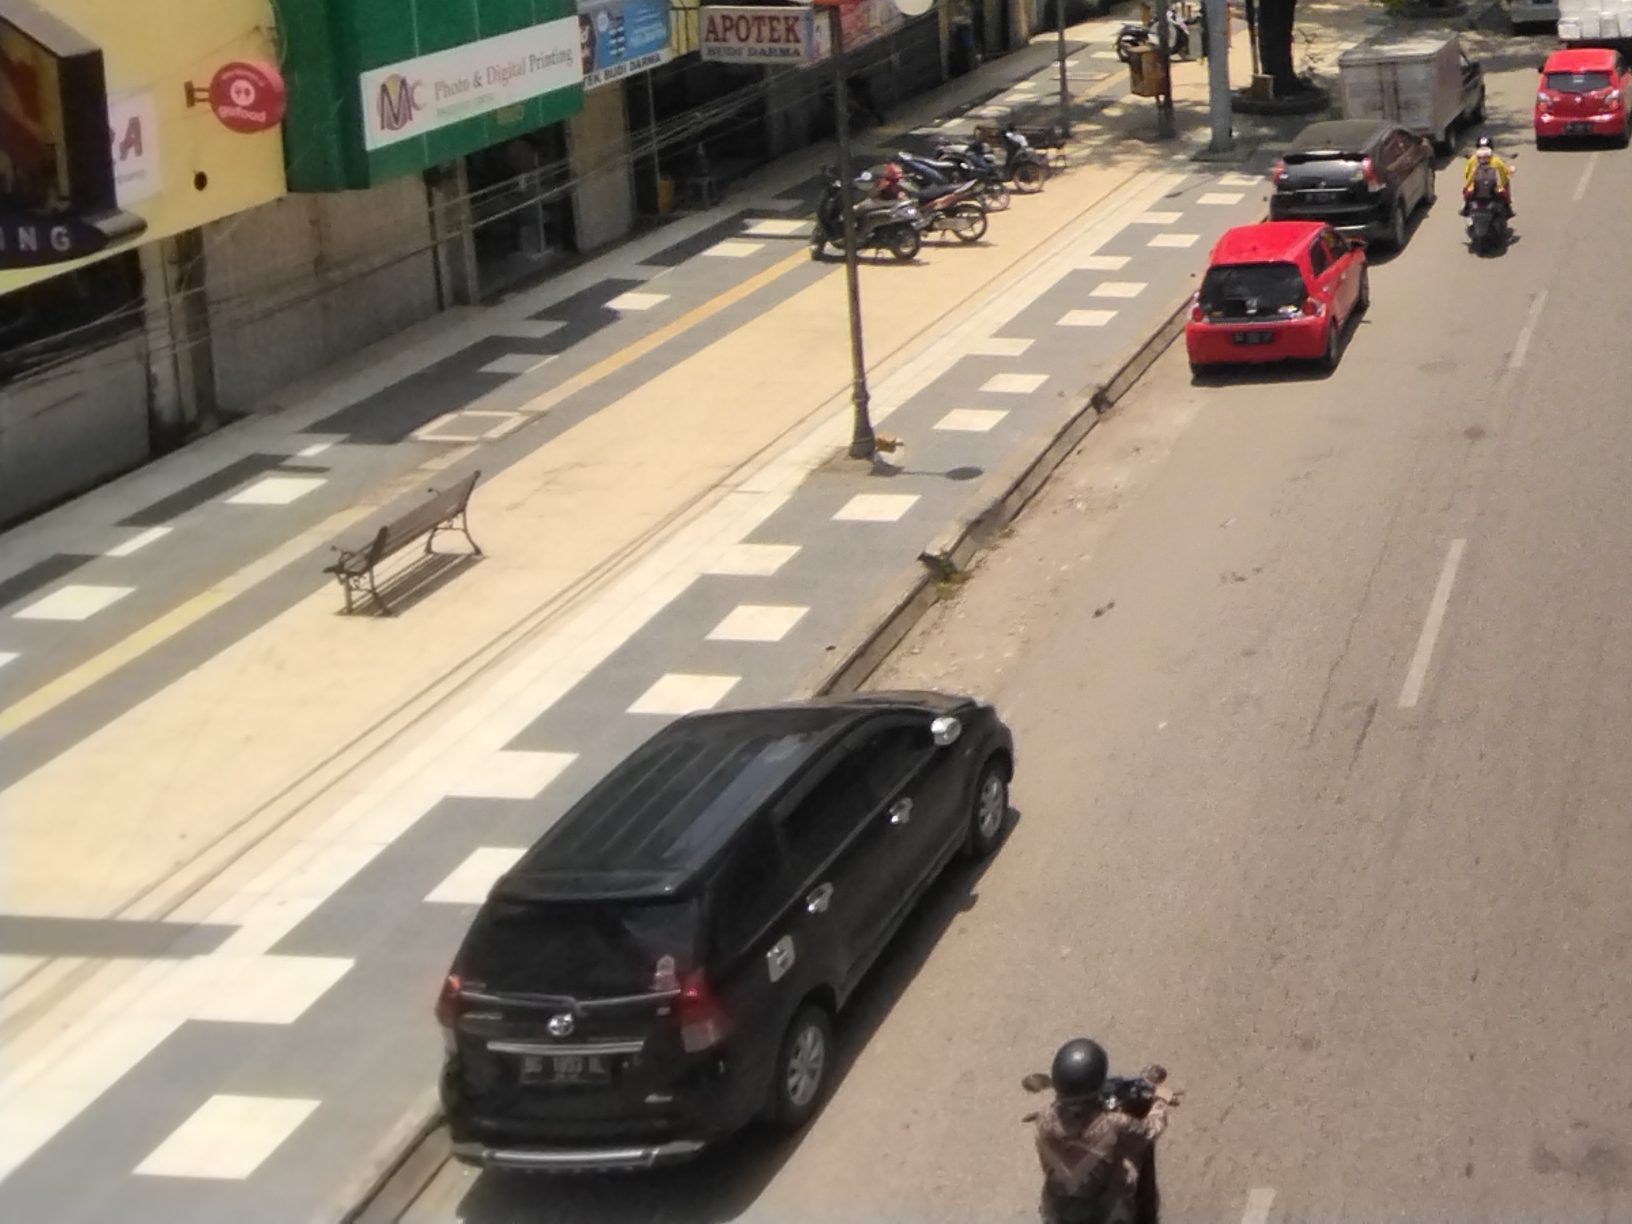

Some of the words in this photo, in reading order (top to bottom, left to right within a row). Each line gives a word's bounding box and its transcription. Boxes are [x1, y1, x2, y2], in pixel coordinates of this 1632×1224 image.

[705, 14, 800, 43] APOTEK
[707, 47, 742, 57] BUDI
[748, 46, 801, 57] DARMA
[434, 76, 470, 101] Photo
[473, 69, 484, 88] &
[486, 57, 526, 87] Digital
[529, 46, 574, 73] Printing
